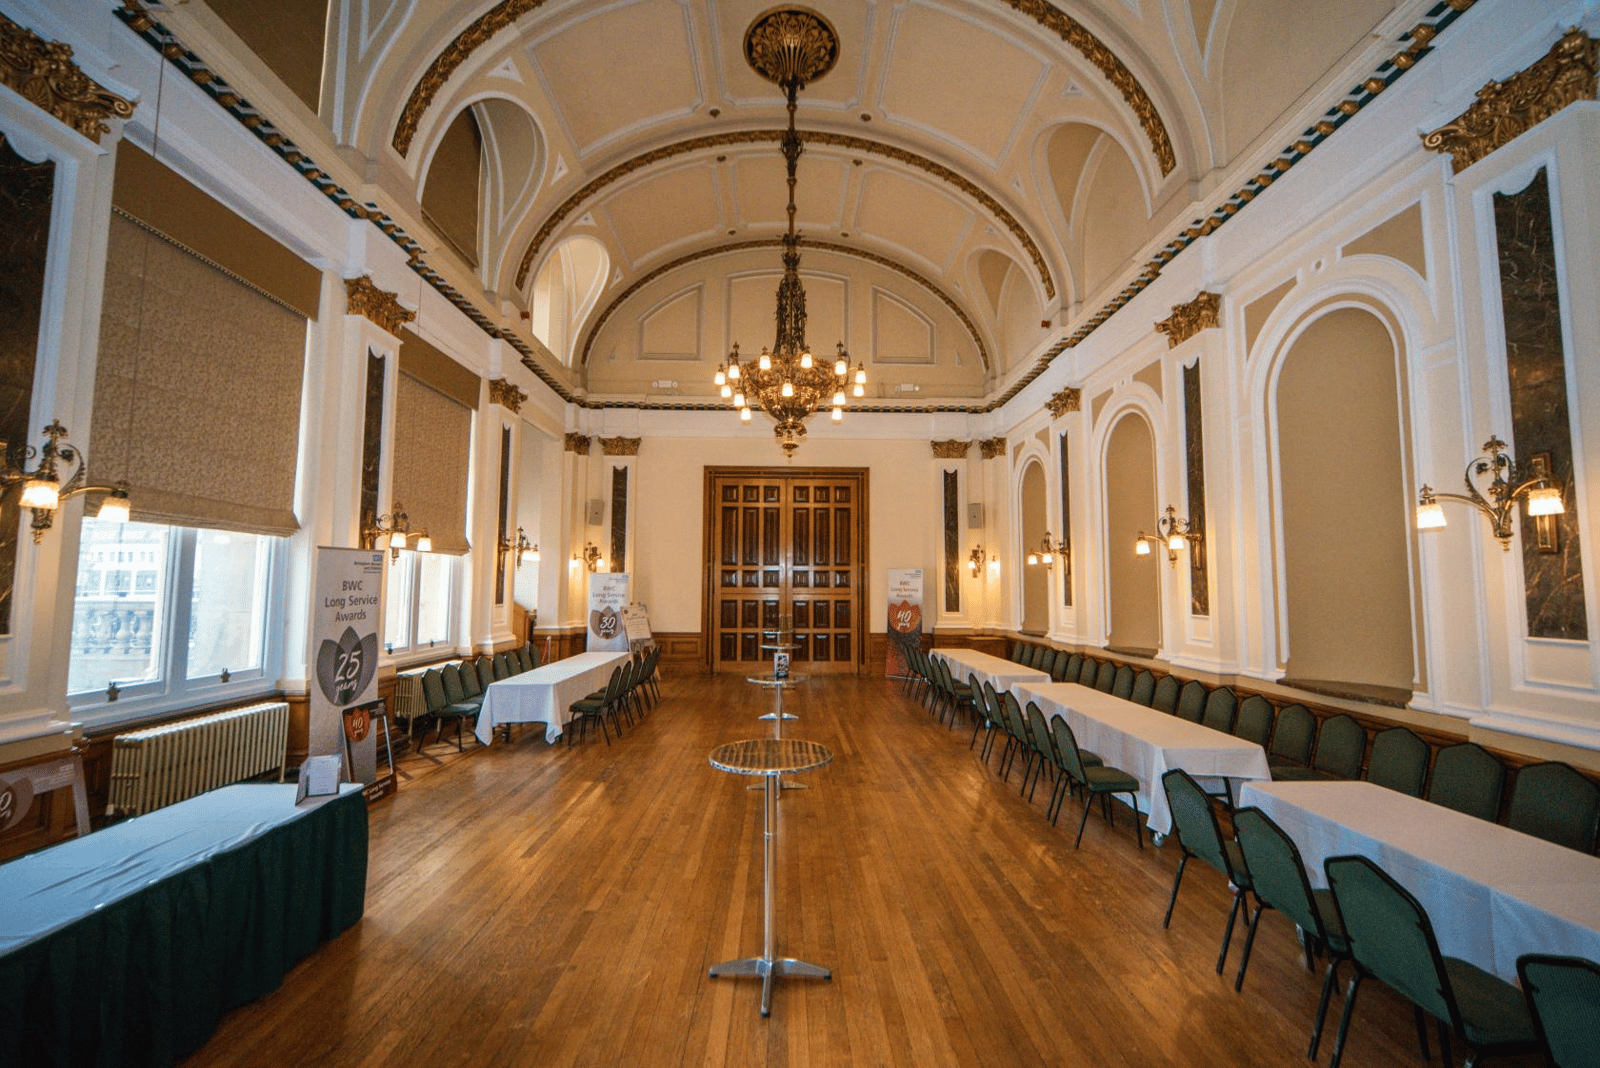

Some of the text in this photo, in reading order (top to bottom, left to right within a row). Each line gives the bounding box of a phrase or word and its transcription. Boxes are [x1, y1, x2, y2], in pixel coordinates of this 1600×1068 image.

[342, 580, 363, 591] BWC
[325, 594, 378, 609] Long Service
[335, 609, 367, 622] Awards
[897, 610, 911, 622] 40
[600, 616, 616, 629] 30
[334, 650, 361, 682] 25
[333, 679, 358, 703] years
[352, 716, 363, 729] 40
